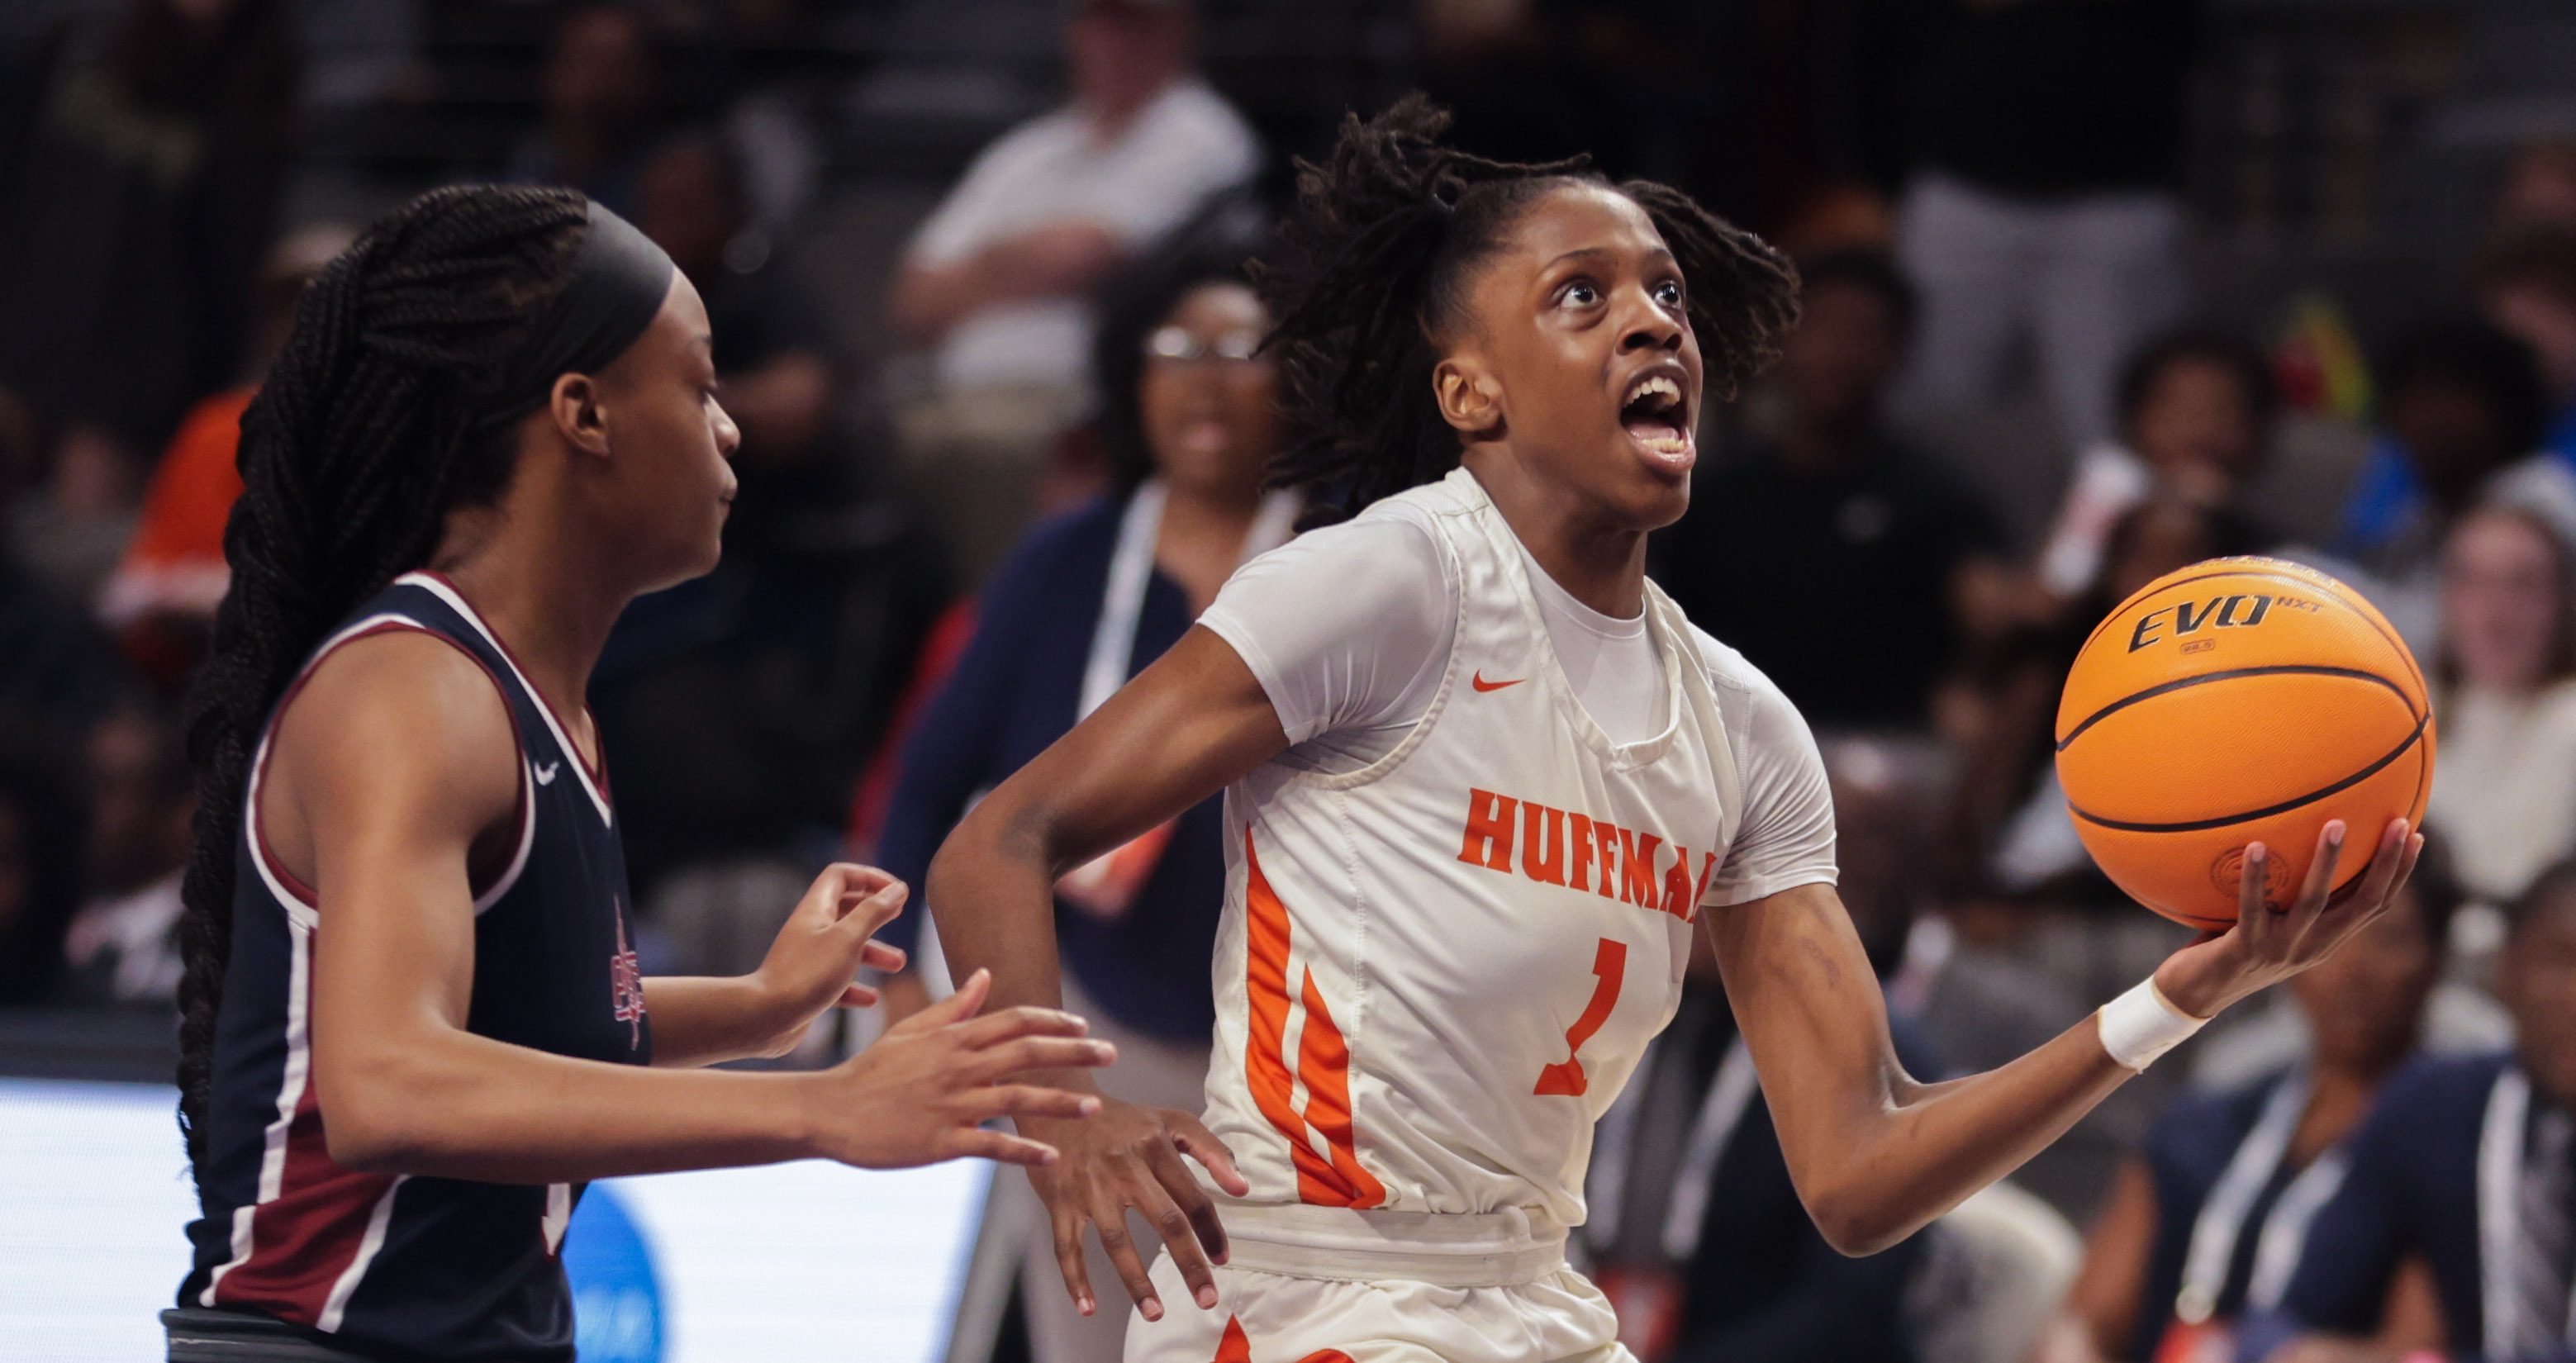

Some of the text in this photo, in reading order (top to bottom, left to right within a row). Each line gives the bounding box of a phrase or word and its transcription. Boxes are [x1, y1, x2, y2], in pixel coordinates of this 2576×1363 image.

[2128, 594, 2323, 653] EVO NXT
[1533, 937, 1627, 1097] 1
